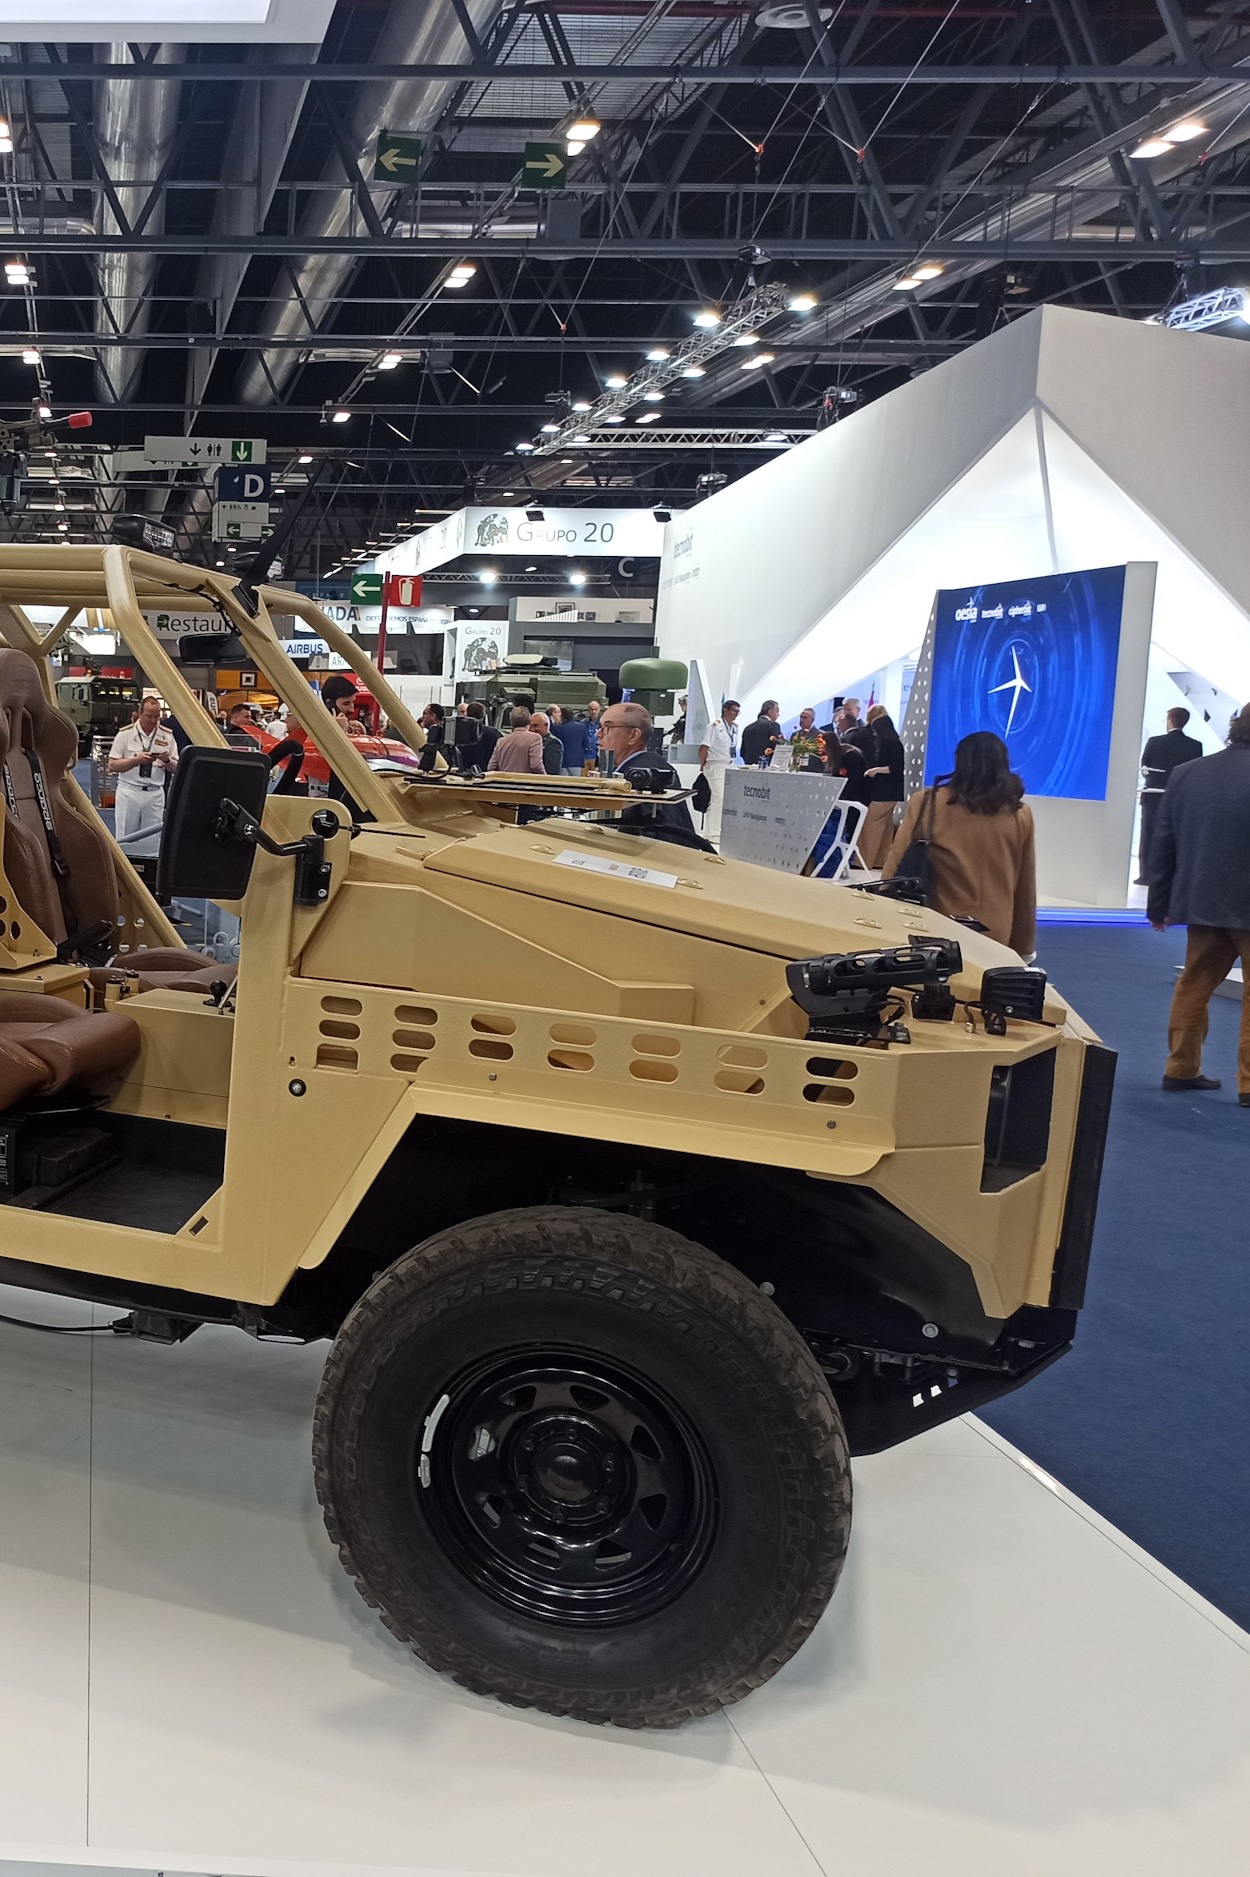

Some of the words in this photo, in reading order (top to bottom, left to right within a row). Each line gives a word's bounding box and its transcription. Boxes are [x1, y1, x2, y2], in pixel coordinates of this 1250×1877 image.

[244, 473, 265, 498] D
[583, 522, 614, 543] 20
[618, 557, 635, 578] C
[489, 627, 501, 636] 20
[286, 643, 323, 654] AIRBUS
[3, 764, 19, 819] sparc
[34, 772, 54, 831] sparco
[744, 785, 771, 800] tecnobit
